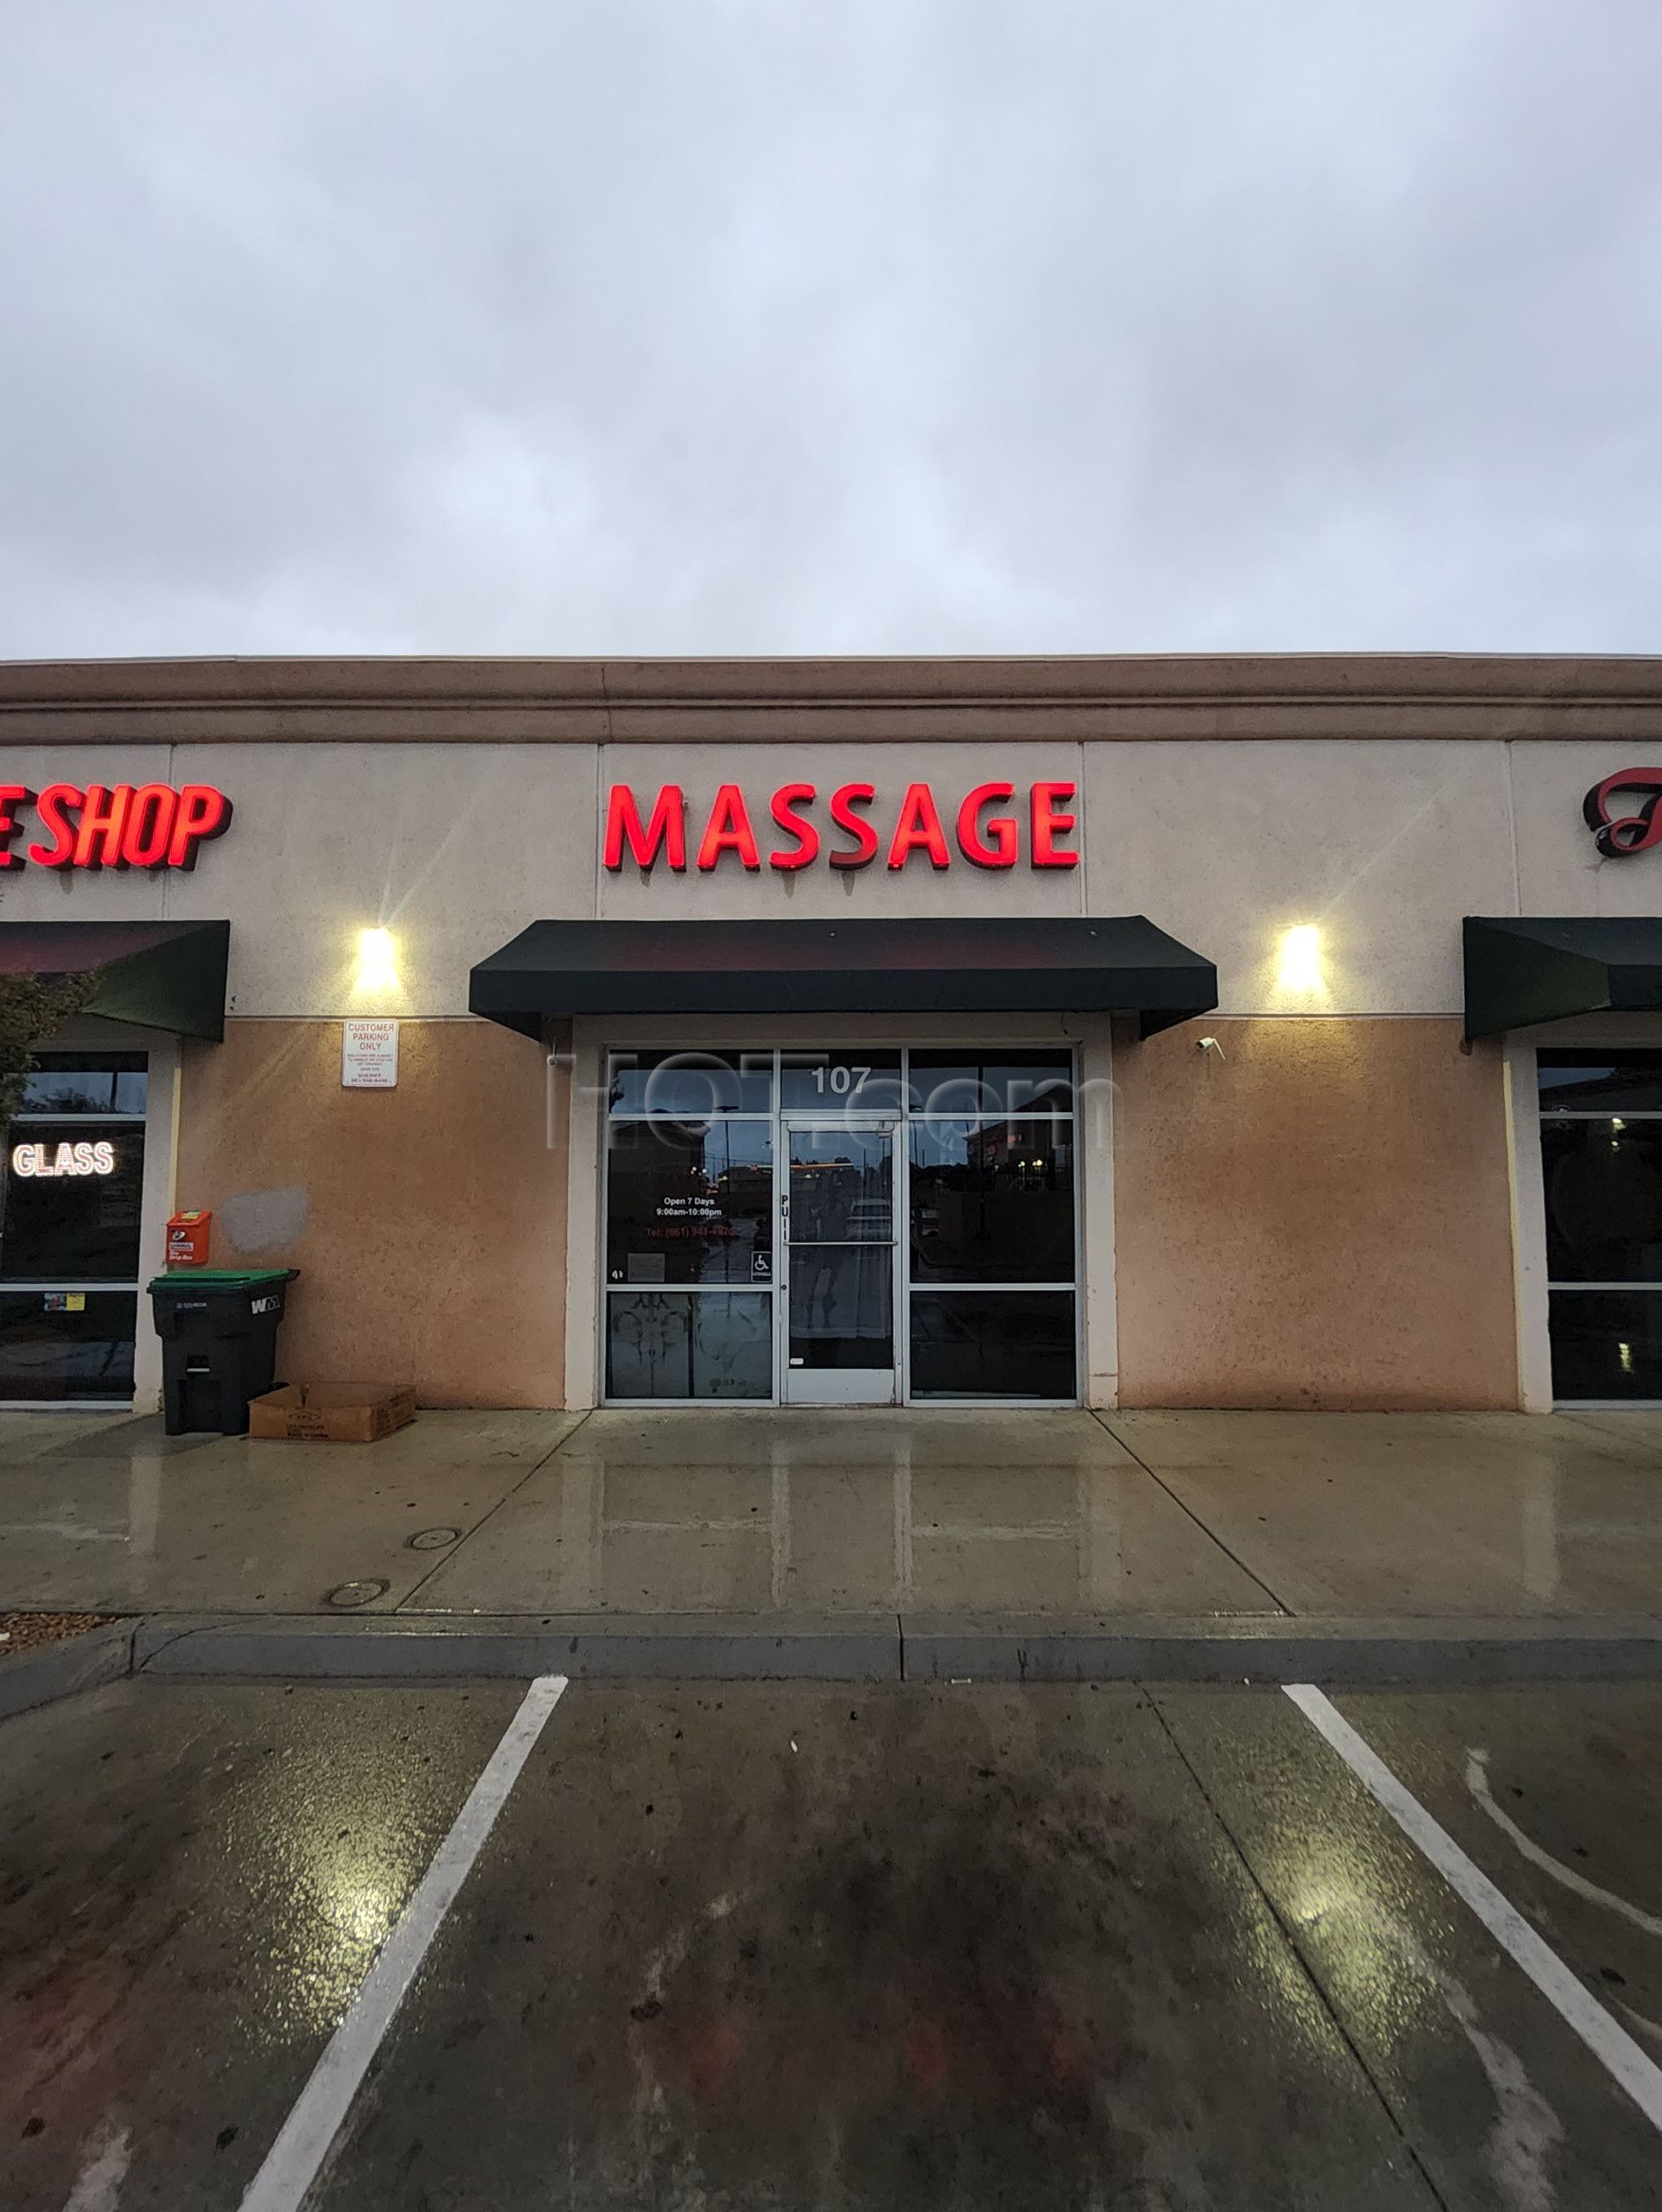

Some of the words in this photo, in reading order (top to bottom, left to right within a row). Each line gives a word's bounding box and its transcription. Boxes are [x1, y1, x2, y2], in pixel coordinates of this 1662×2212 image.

[29, 783, 232, 871] SHOP
[604, 782, 1079, 871] MASSAGE
[347, 1023, 395, 1032] CUSTOMER
[353, 1033, 389, 1041] PARKING
[359, 1042, 382, 1051] ONLY
[811, 1065, 872, 1096] 107
[12, 1141, 115, 1177] GLASS
[664, 1197, 685, 1206] Open
[694, 1197, 715, 1206] Days
[656, 1208, 723, 1217] 9:00am-10:00pm
[251, 1294, 281, 1315] WM
